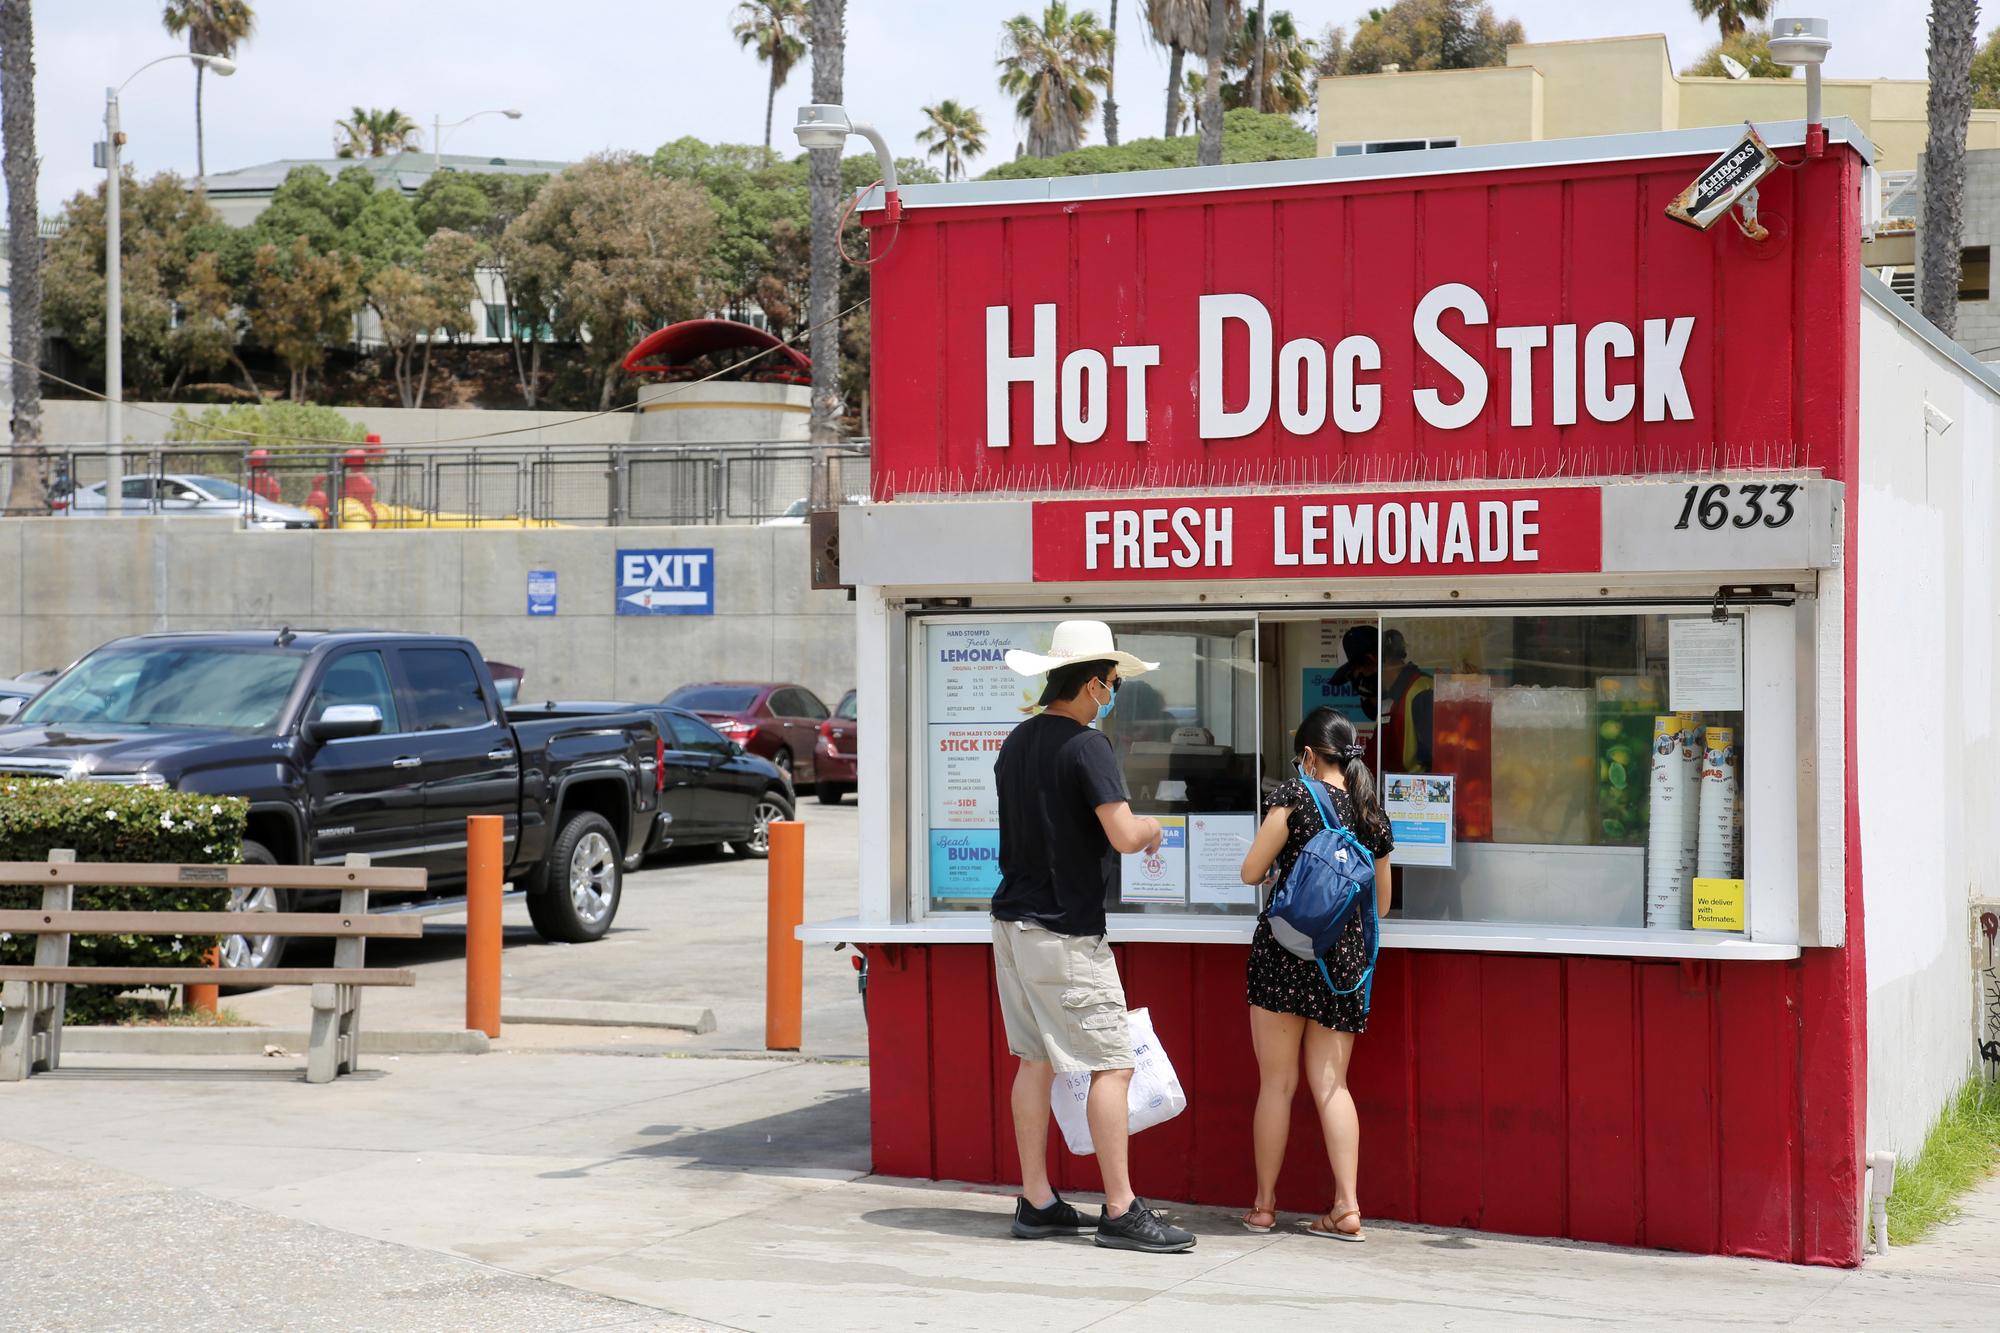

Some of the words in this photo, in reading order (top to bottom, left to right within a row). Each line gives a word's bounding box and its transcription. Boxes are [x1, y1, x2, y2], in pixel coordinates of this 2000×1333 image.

[1706, 177, 1727, 198] SKATE
[1725, 166, 1742, 185] SHOP
[986, 303, 1160, 447] HOT
[1199, 293, 1381, 439] DOG
[1413, 282, 1696, 430] STICK
[1674, 483, 1798, 531] 1633
[1085, 507, 1233, 569] FRESH
[1273, 500, 1539, 566] LEMONADE
[623, 555, 707, 586] EXIT
[965, 639, 988, 648] Fresh
[941, 648, 1015, 663] LEMONA
[940, 739, 980, 752] STICK
[936, 835, 970, 849] Beach
[948, 847, 999, 861] BUNDL
[1065, 1076, 1081, 1090] it's
[1074, 1092, 1086, 1102] to
